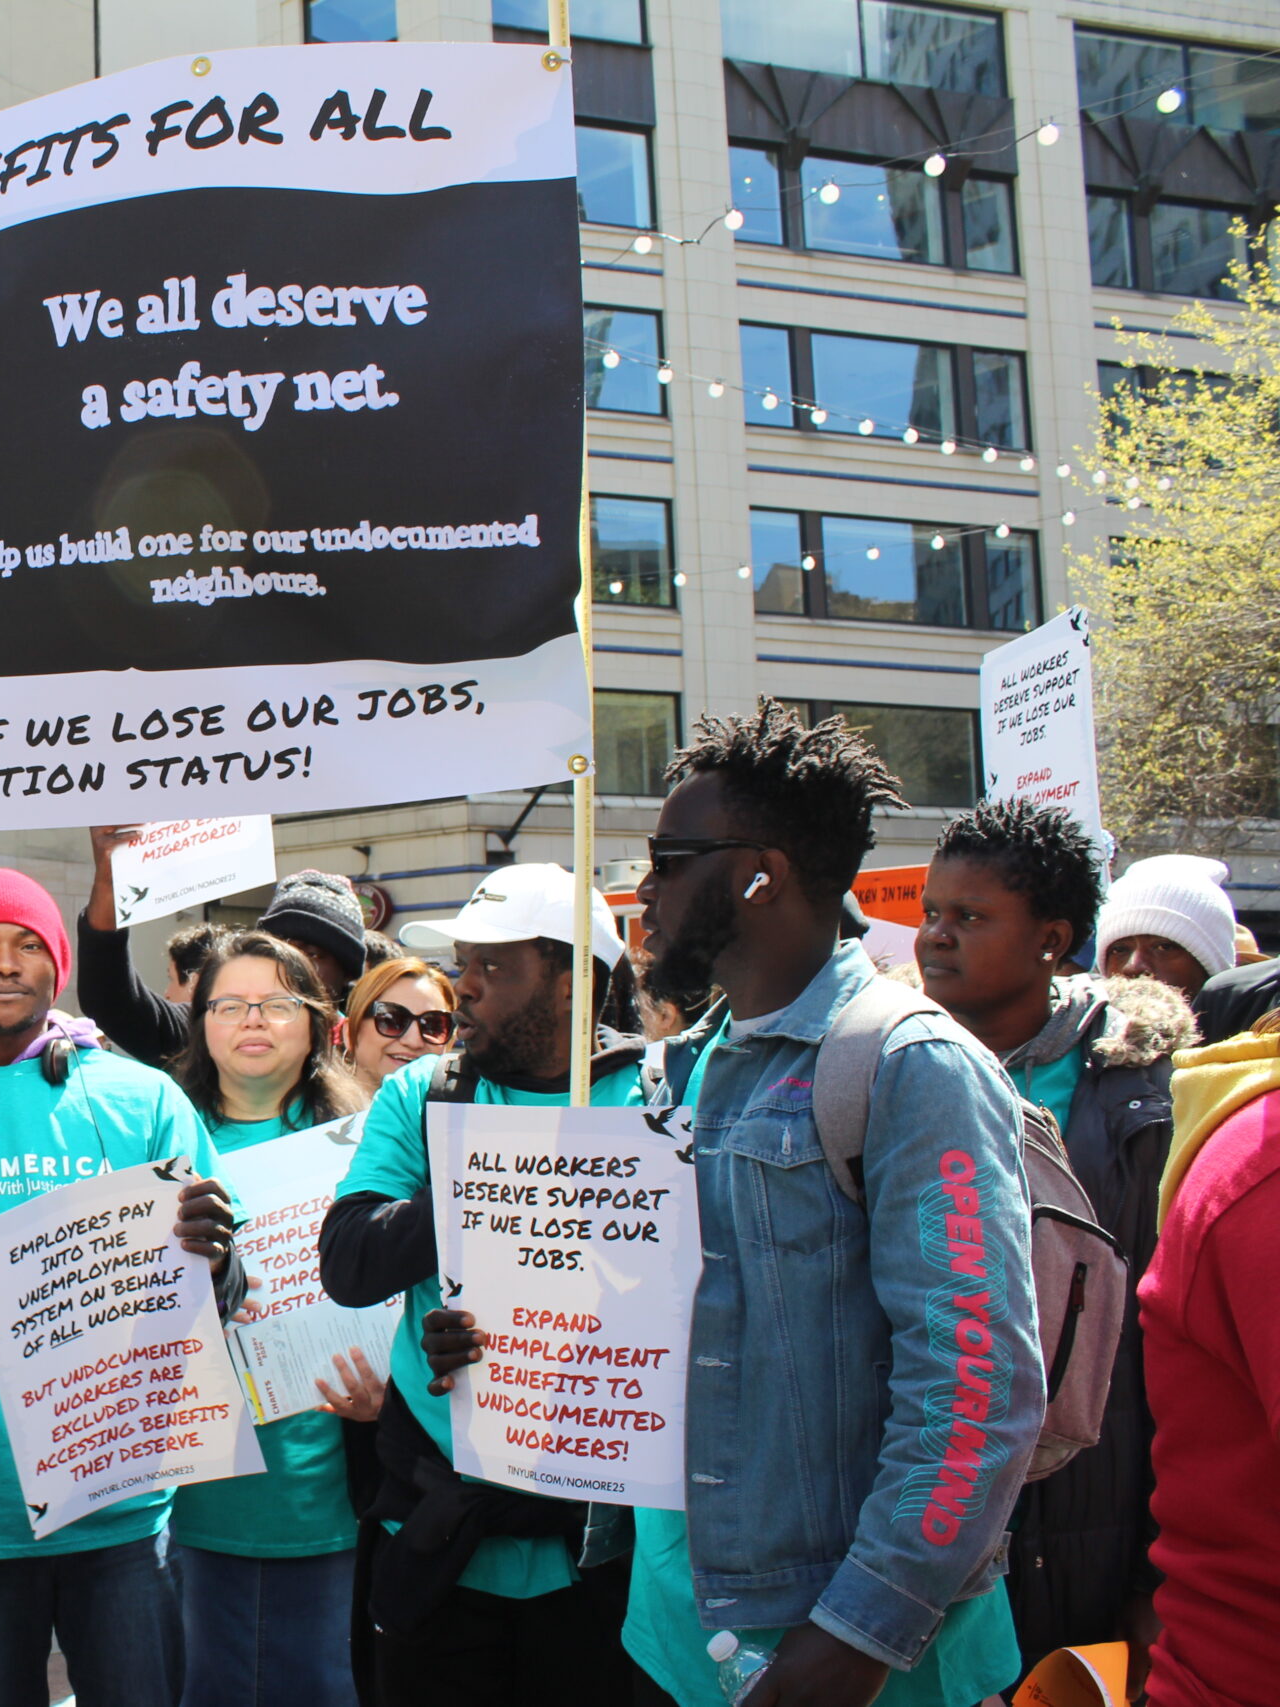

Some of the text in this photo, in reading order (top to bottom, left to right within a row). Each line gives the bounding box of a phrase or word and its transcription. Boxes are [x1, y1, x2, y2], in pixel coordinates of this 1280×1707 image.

[146, 93, 283, 156] FOR
[310, 89, 451, 141] ALL
[43, 273, 428, 347] We all deserve
[81, 361, 399, 431] a safety net.
[25, 544, 55, 568] us
[60, 527, 134, 565] build
[138, 533, 193, 557] one
[200, 524, 247, 552] for
[253, 531, 308, 553] our
[311, 514, 540, 552] undocumented
[150, 566, 326, 606] neighbours.
[994, 669, 1080, 715] DESERVE SUPPORT
[1001, 650, 1069, 692] ALL WORKERS
[26, 715, 90, 747] WE
[112, 705, 225, 742] LOSE
[247, 695, 338, 732] OUR
[358, 680, 484, 720] JOBS,
[997, 694, 1075, 735] IF WE LOSE OUR
[1020, 724, 1047, 746] JOBS.
[127, 746, 311, 790] STATUS!
[1017, 767, 1052, 790] EXPAND
[142, 821, 241, 863] MIGRATORIO!
[468, 1152, 640, 1178] ALL WORKERS
[26, 1177, 69, 1197] Justic
[453, 1180, 670, 1210] DESERVE SUPPORT
[9, 1200, 155, 1265] EMPLOYERS PAY
[462, 1211, 659, 1242] IF WE LOSE OUR
[939, 1149, 986, 1278] OPEN
[41, 1231, 128, 1276] INTO THE
[518, 1248, 583, 1271] JOBS.
[19, 1246, 169, 1310] UNEMPLOYMENT
[270, 1267, 320, 1294] IMPO
[11, 1267, 185, 1339] SYSTEM ON BEHALF
[513, 1308, 602, 1334] EXPAND
[23, 1292, 181, 1359] OF ALL WORKERS.
[484, 1333, 670, 1369] NEMPLOYMENT
[951, 1291, 994, 1421] YOUR
[22, 1338, 203, 1408] BUT UNDOCUMENTED
[54, 1364, 184, 1417] WORKERS ARE
[488, 1363, 642, 1399] BENEFITS TO
[52, 1386, 199, 1444] EXCLUDED FROM
[264, 1380, 279, 1414] CHANTS
[477, 1392, 665, 1432] UNDOCUMENTED
[36, 1404, 229, 1476] ACCESSING BENEFITS
[70, 1432, 203, 1483] THEY DESERVE.
[507, 1427, 628, 1461] WORKERS!
[88, 1464, 195, 1502] TINYURL.COM/NOMORE25
[507, 1465, 624, 1492] TINYURL.COM/NOMORE25
